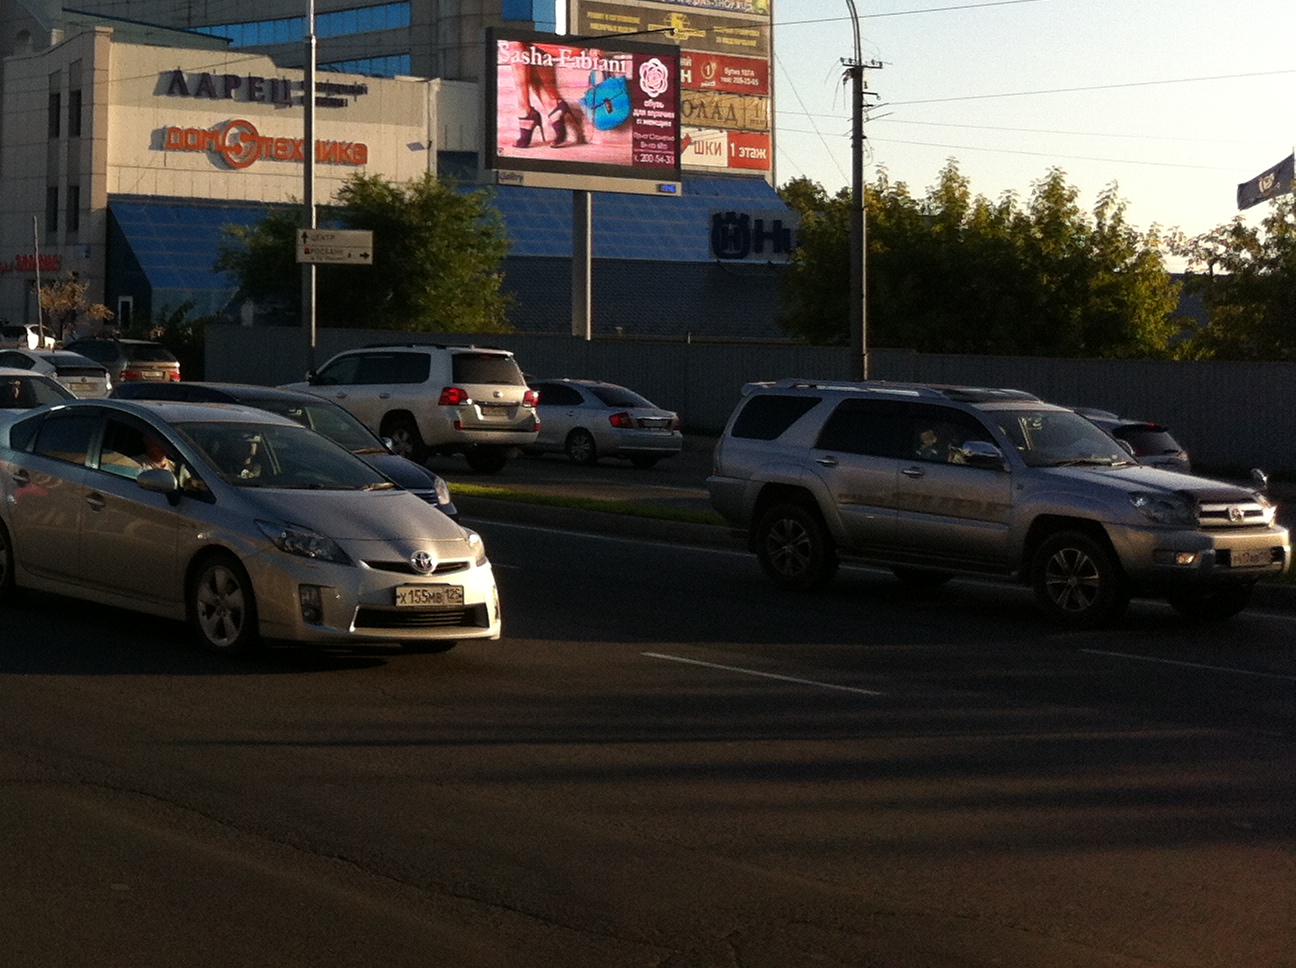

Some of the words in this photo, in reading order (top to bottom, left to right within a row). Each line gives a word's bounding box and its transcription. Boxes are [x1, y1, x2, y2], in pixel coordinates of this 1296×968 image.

[497, 40, 553, 67] Sasha
[557, 48, 626, 73] Fabiani
[166, 69, 292, 108] ЛАРЕЦ
[730, 142, 735, 157] 1
[738, 147, 767, 159] этаж
